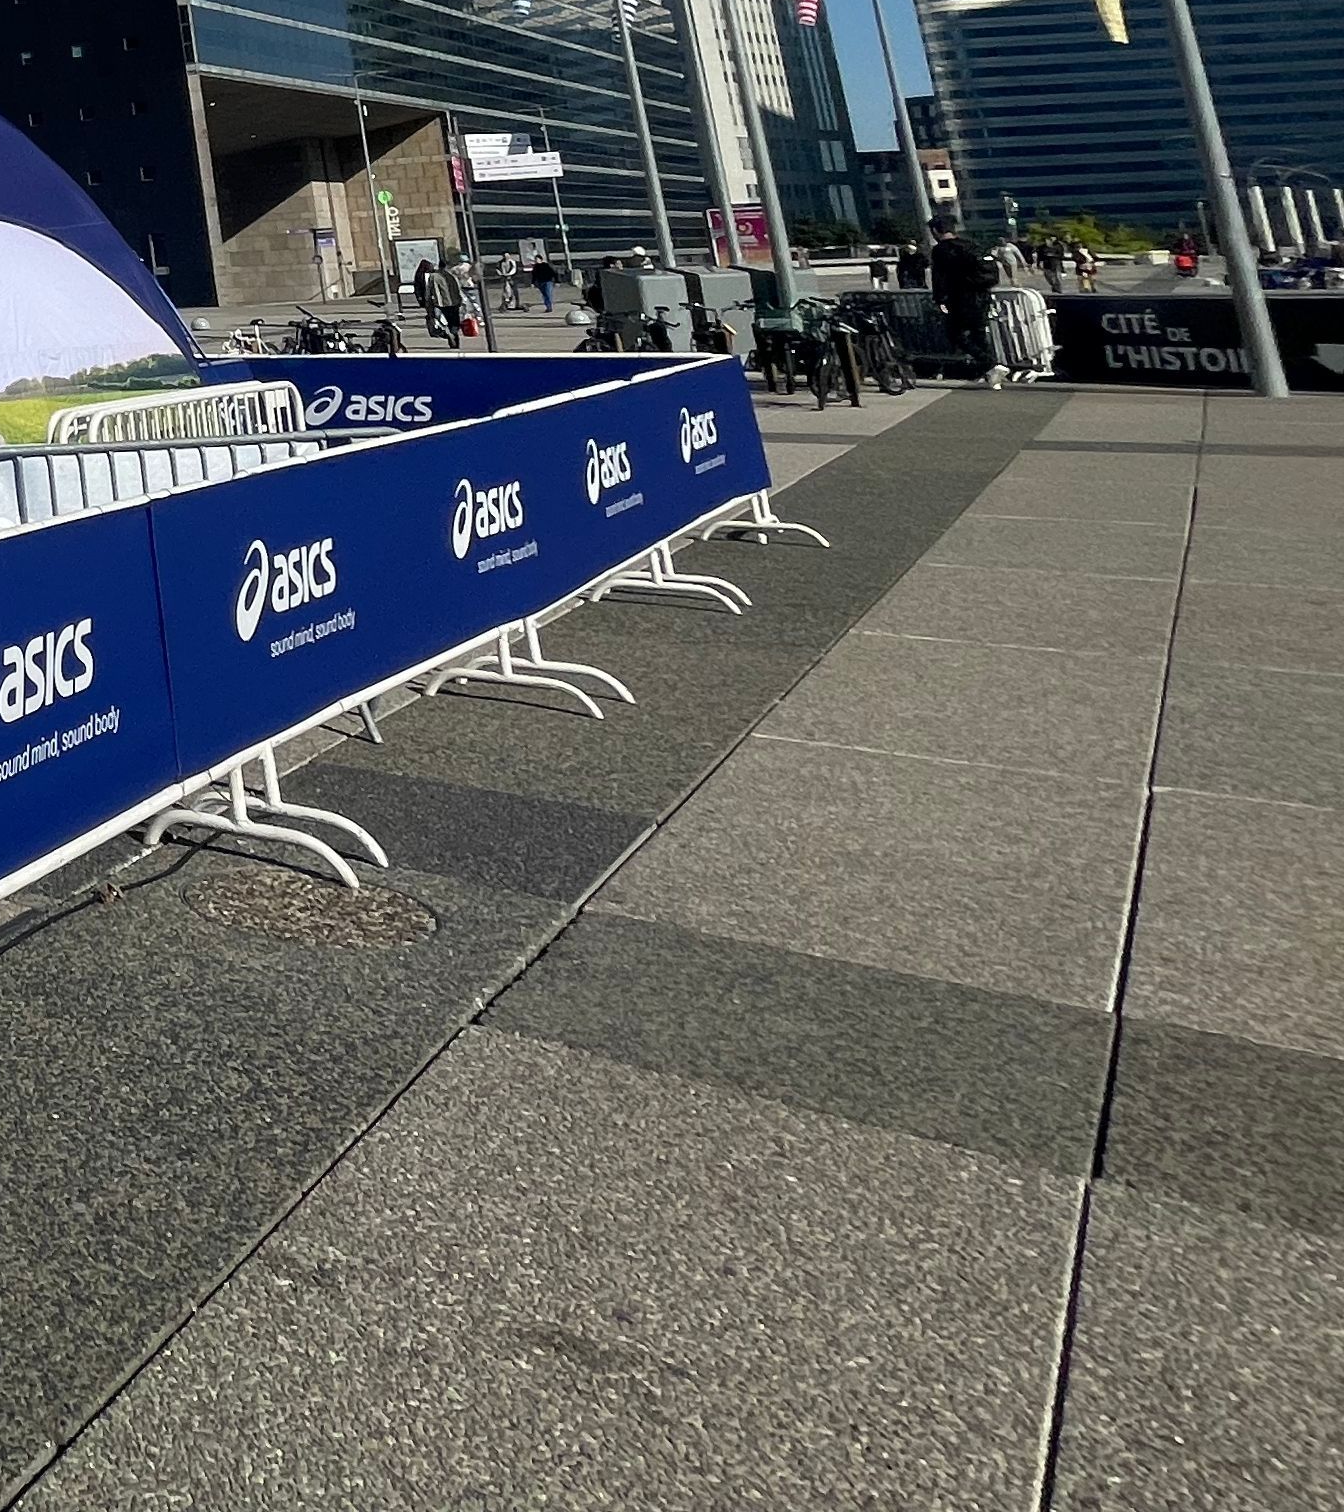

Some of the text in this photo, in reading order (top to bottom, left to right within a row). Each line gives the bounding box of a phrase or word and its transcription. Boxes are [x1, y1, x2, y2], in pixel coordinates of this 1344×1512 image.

[1101, 308, 1192, 342] CITÉ DE
[345, 394, 433, 422] asics
[475, 480, 524, 539] asics
[271, 537, 336, 613] asics
[31, 731, 60, 766] mind,
[61, 715, 94, 752] sound
[94, 704, 120, 735] body
